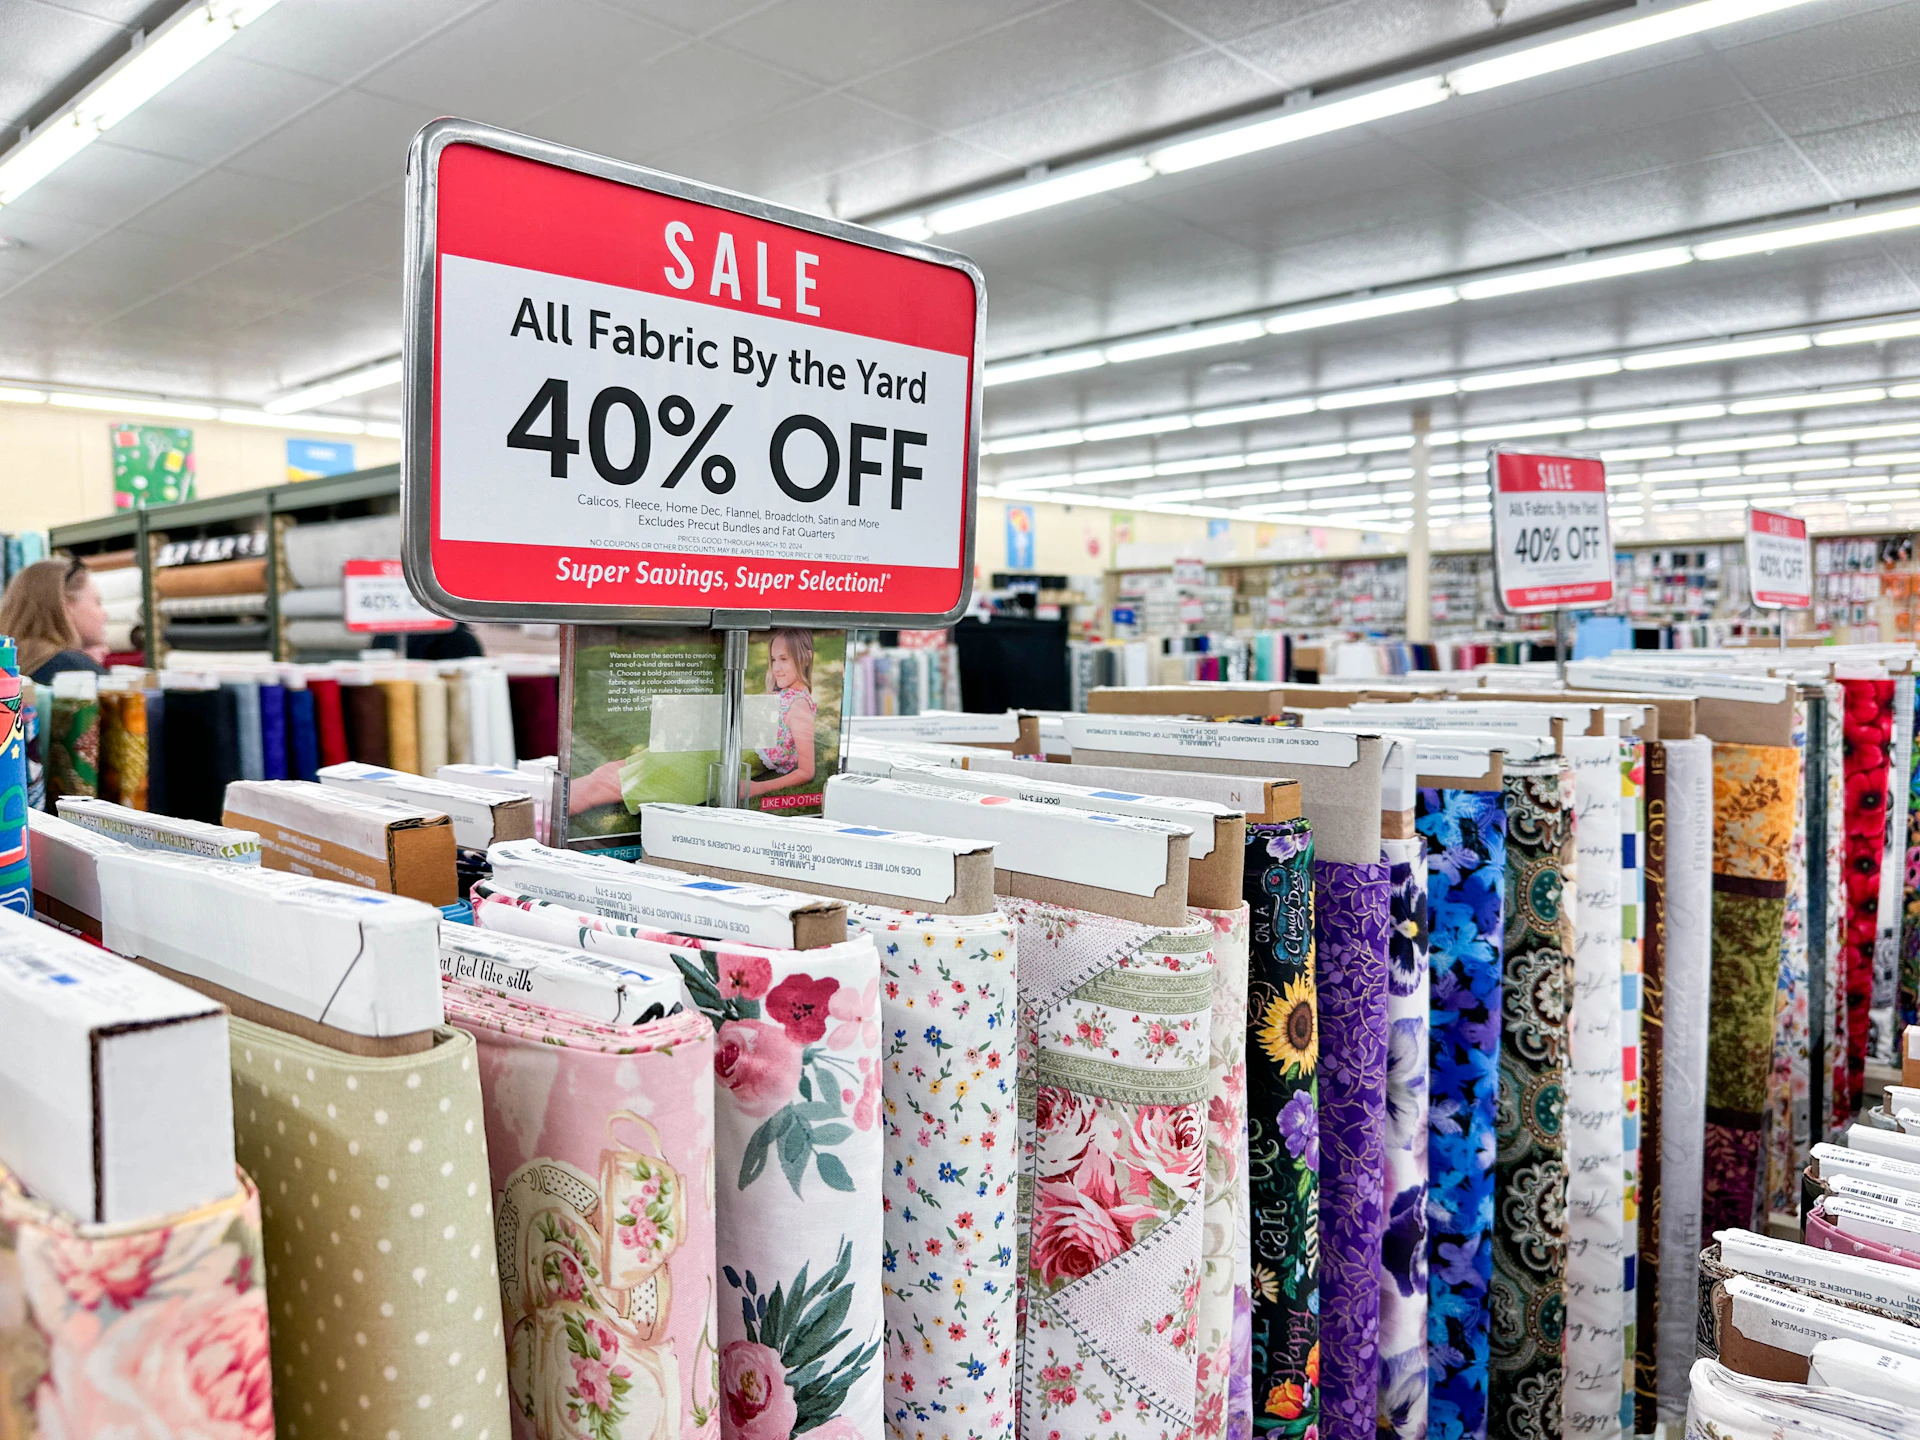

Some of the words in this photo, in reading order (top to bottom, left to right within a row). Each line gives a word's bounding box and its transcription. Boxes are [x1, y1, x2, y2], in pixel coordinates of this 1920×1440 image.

[664, 220, 820, 318] SALE
[511, 297, 572, 346] All
[589, 309, 718, 369] Fabric
[733, 336, 778, 388] By
[789, 350, 846, 391] the
[856, 359, 927, 404] Yard
[507, 378, 736, 495] 40%
[770, 414, 928, 510] OFF
[1538, 464, 1574, 489] SALE
[578, 494, 622, 508] Calicos,
[625, 498, 662, 512] Fleece,
[666, 502, 698, 514] Home
[701, 504, 722, 518] Dec,
[726, 507, 762, 520] Flannel,
[765, 510, 816, 525] Broadcloth,
[818, 515, 839, 526] Satin
[841, 518, 856, 528] and
[859, 519, 880, 529] More
[638, 514, 684, 528] Excludes
[688, 519, 720, 532] Precut
[723, 522, 760, 534] Bundles
[763, 526, 780, 536] and
[782, 526, 796, 537] Fat
[798, 528, 836, 540] Quarters
[604, 540, 640, 548] COUPONS
[654, 542, 676, 550] OTHER
[678, 544, 716, 553] DISCOUNTS
[1515, 527, 1560, 564] 40%
[1567, 526, 1599, 560] OFF
[556, 556, 630, 588] Super
[636, 561, 728, 593] Savings,
[735, 566, 794, 595] Super
[762, 798, 779, 808] LIKE
[782, 797, 796, 806] NO
[1044, 797, 1060, 805] (DOC
[1646, 798, 1665, 861] GOD
[672, 835, 706, 846] SLEEPWEAR
[707, 839, 740, 851] CHILDREN'S
[191, 839, 220, 858] ROBERT
[752, 846, 795, 859] FLAMMABILITY
[797, 844, 812, 853] (DOC
[798, 853, 810, 861] THE
[812, 854, 825, 863] FOR
[827, 856, 862, 868] STANDARD
[865, 861, 883, 871] MEET
[884, 864, 900, 873] NOT
[901, 866, 921, 876] DOES
[515, 882, 544, 894] SLEEPWEAR
[545, 887, 576, 900] CHILDREN'S
[1284, 869, 1305, 905] Day
[586, 895, 626, 910] FLAMMABILITY
[618, 892, 632, 901] (DOC
[628, 904, 640, 913] THE
[642, 906, 654, 916] FOR
[1254, 905, 1270, 915] A
[656, 909, 691, 922] STANDARD
[694, 915, 712, 926] MEET
[714, 920, 728, 929] NOT
[730, 923, 750, 933] DOES
[1281, 905, 1306, 954] Cloudy
[1254, 922, 1270, 942] ON
[455, 955, 478, 978] feel
[480, 960, 503, 984] like
[507, 969, 533, 992] silk
[1766, 1269, 1816, 1286] SLEEPWEAR
[1820, 1282, 1872, 1300] CHILDREN'S
[1771, 1318, 1827, 1341] SLEEPWEAR
[1272, 1308, 1312, 1381] Happy
